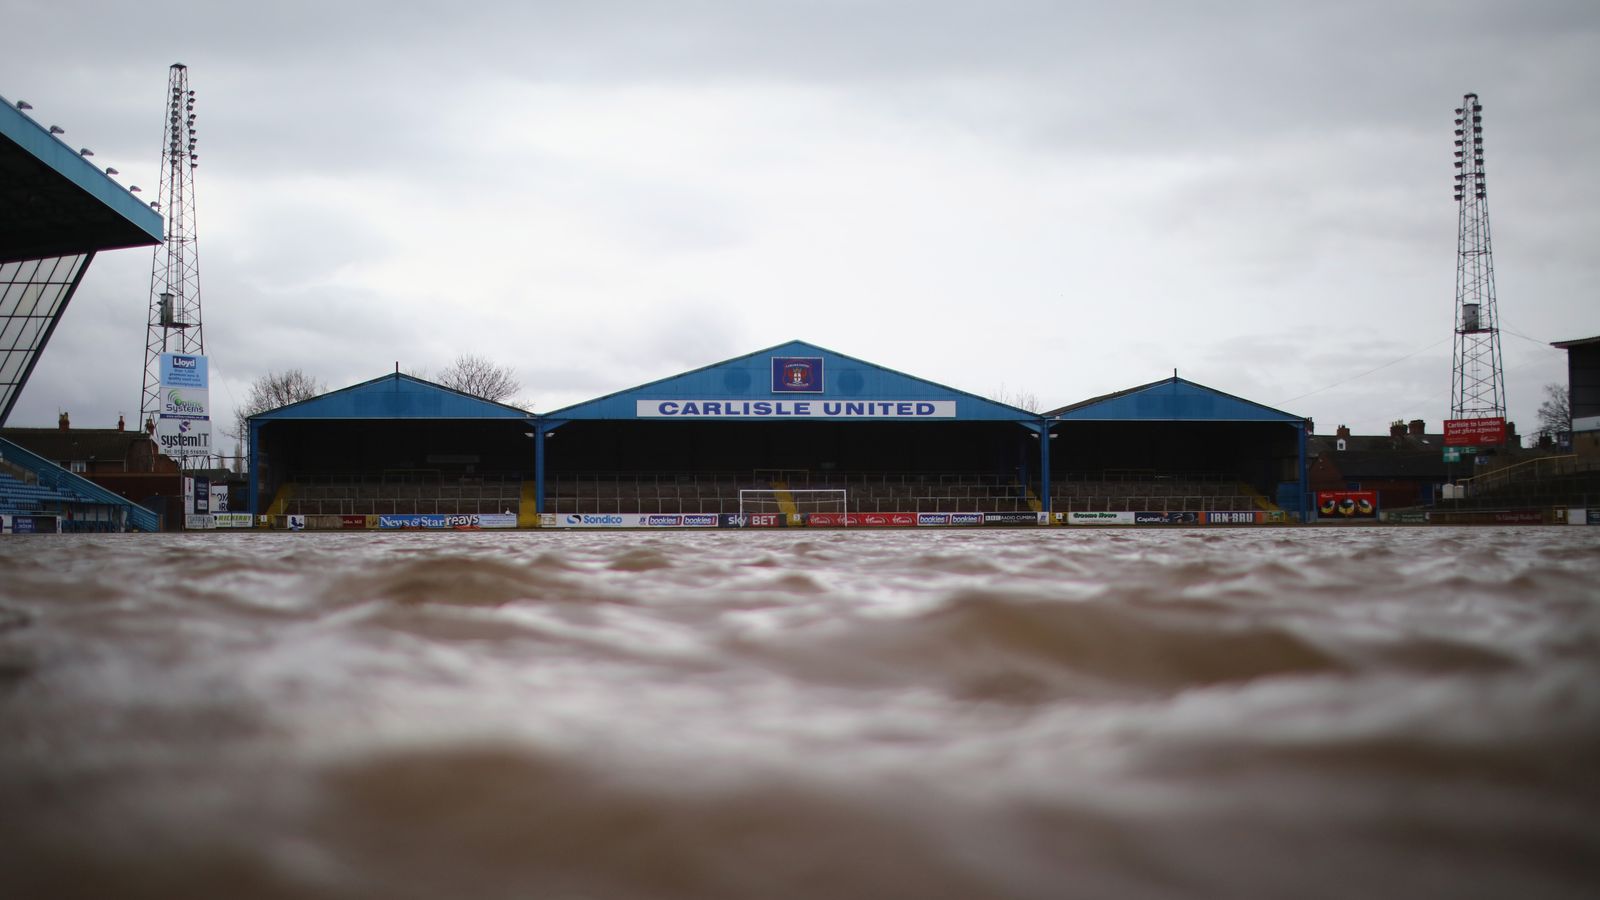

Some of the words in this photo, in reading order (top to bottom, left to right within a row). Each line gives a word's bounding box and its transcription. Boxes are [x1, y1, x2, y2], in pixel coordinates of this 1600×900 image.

[173, 358, 196, 368] Lloyd
[166, 403, 204, 413] Systems
[658, 401, 811, 416] CARLISLE
[823, 401, 936, 416] UNITED
[380, 516, 410, 528] News
[411, 517, 420, 527] &
[421, 516, 445, 527] Star
[445, 514, 479, 527] reays
[584, 515, 623, 524] Sondico
[728, 514, 747, 526] sky
[752, 515, 776, 525] BET
[1210, 513, 1253, 523] IRN-BRU
